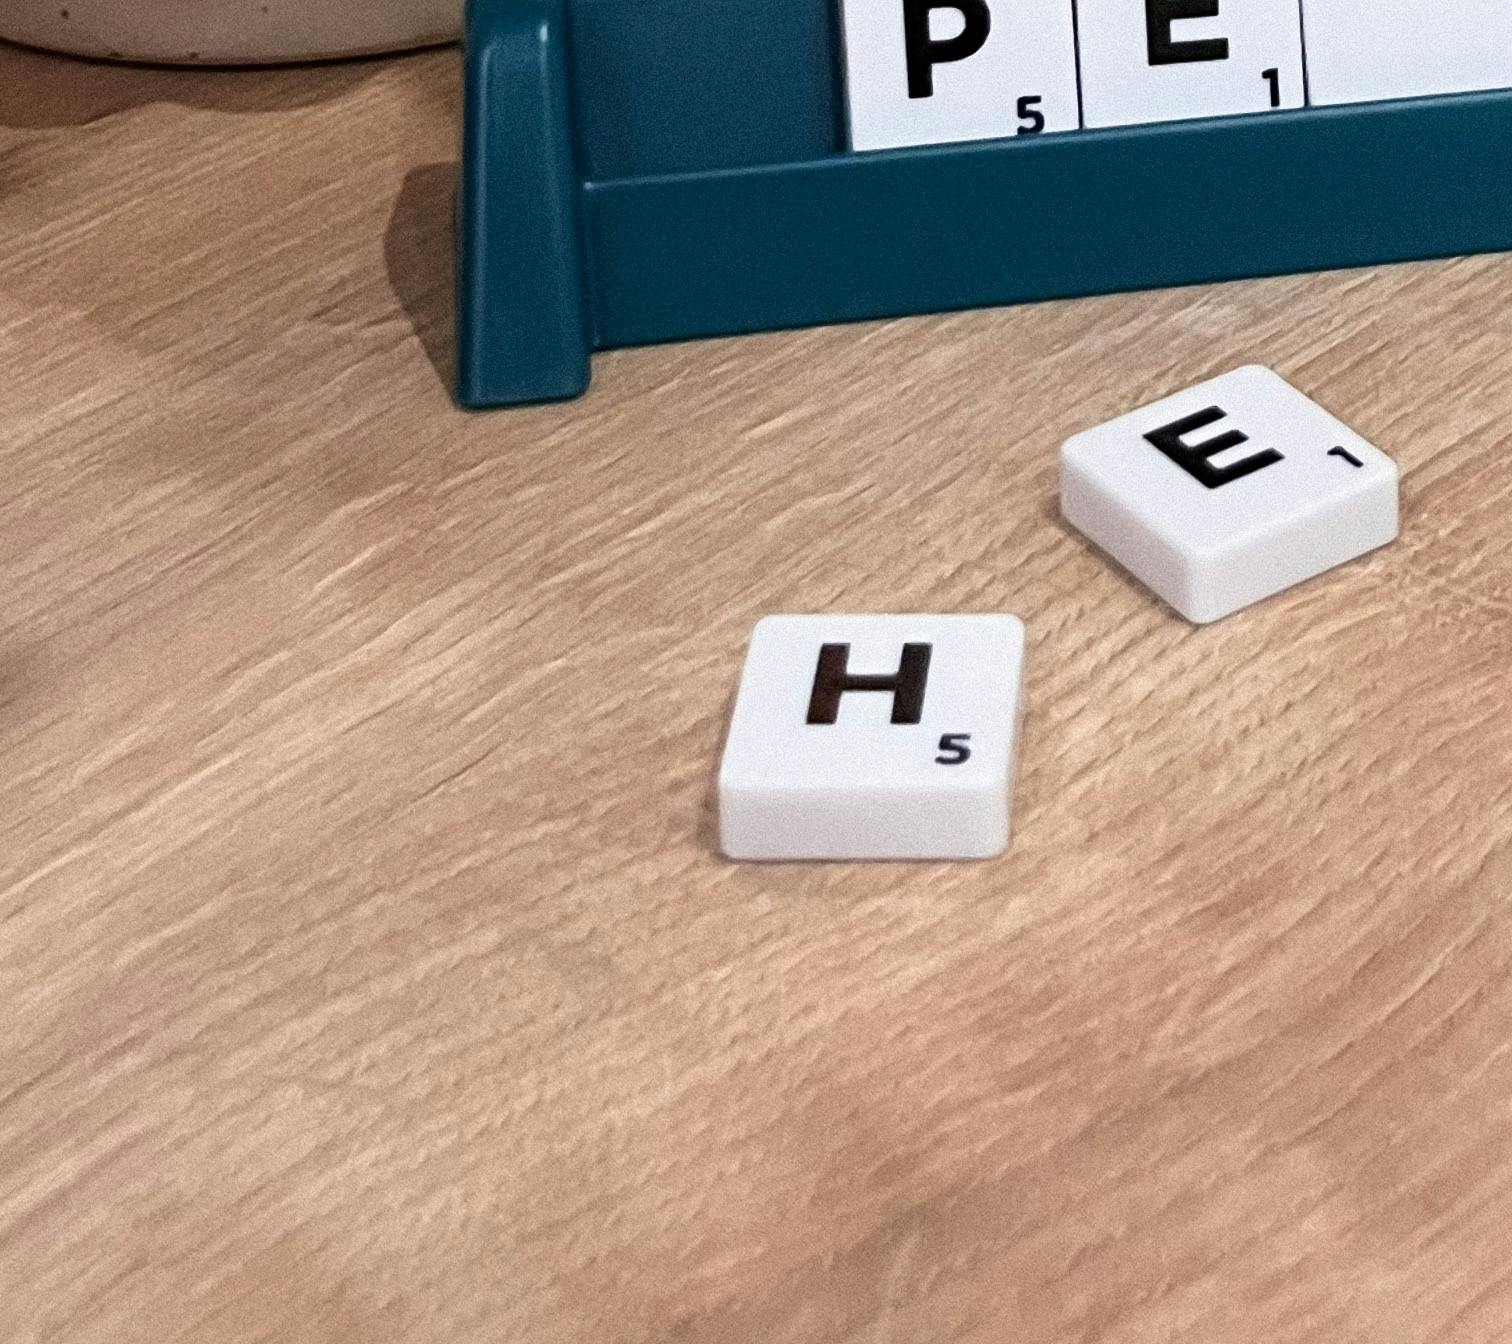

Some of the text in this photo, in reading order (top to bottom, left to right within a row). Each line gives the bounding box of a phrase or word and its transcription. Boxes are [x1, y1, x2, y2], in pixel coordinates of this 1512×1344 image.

[1016, 94, 1045, 136] 5
[1261, 67, 1280, 108] 1
[1142, 403, 1365, 490] E 1
[805, 642, 973, 766] H 5
